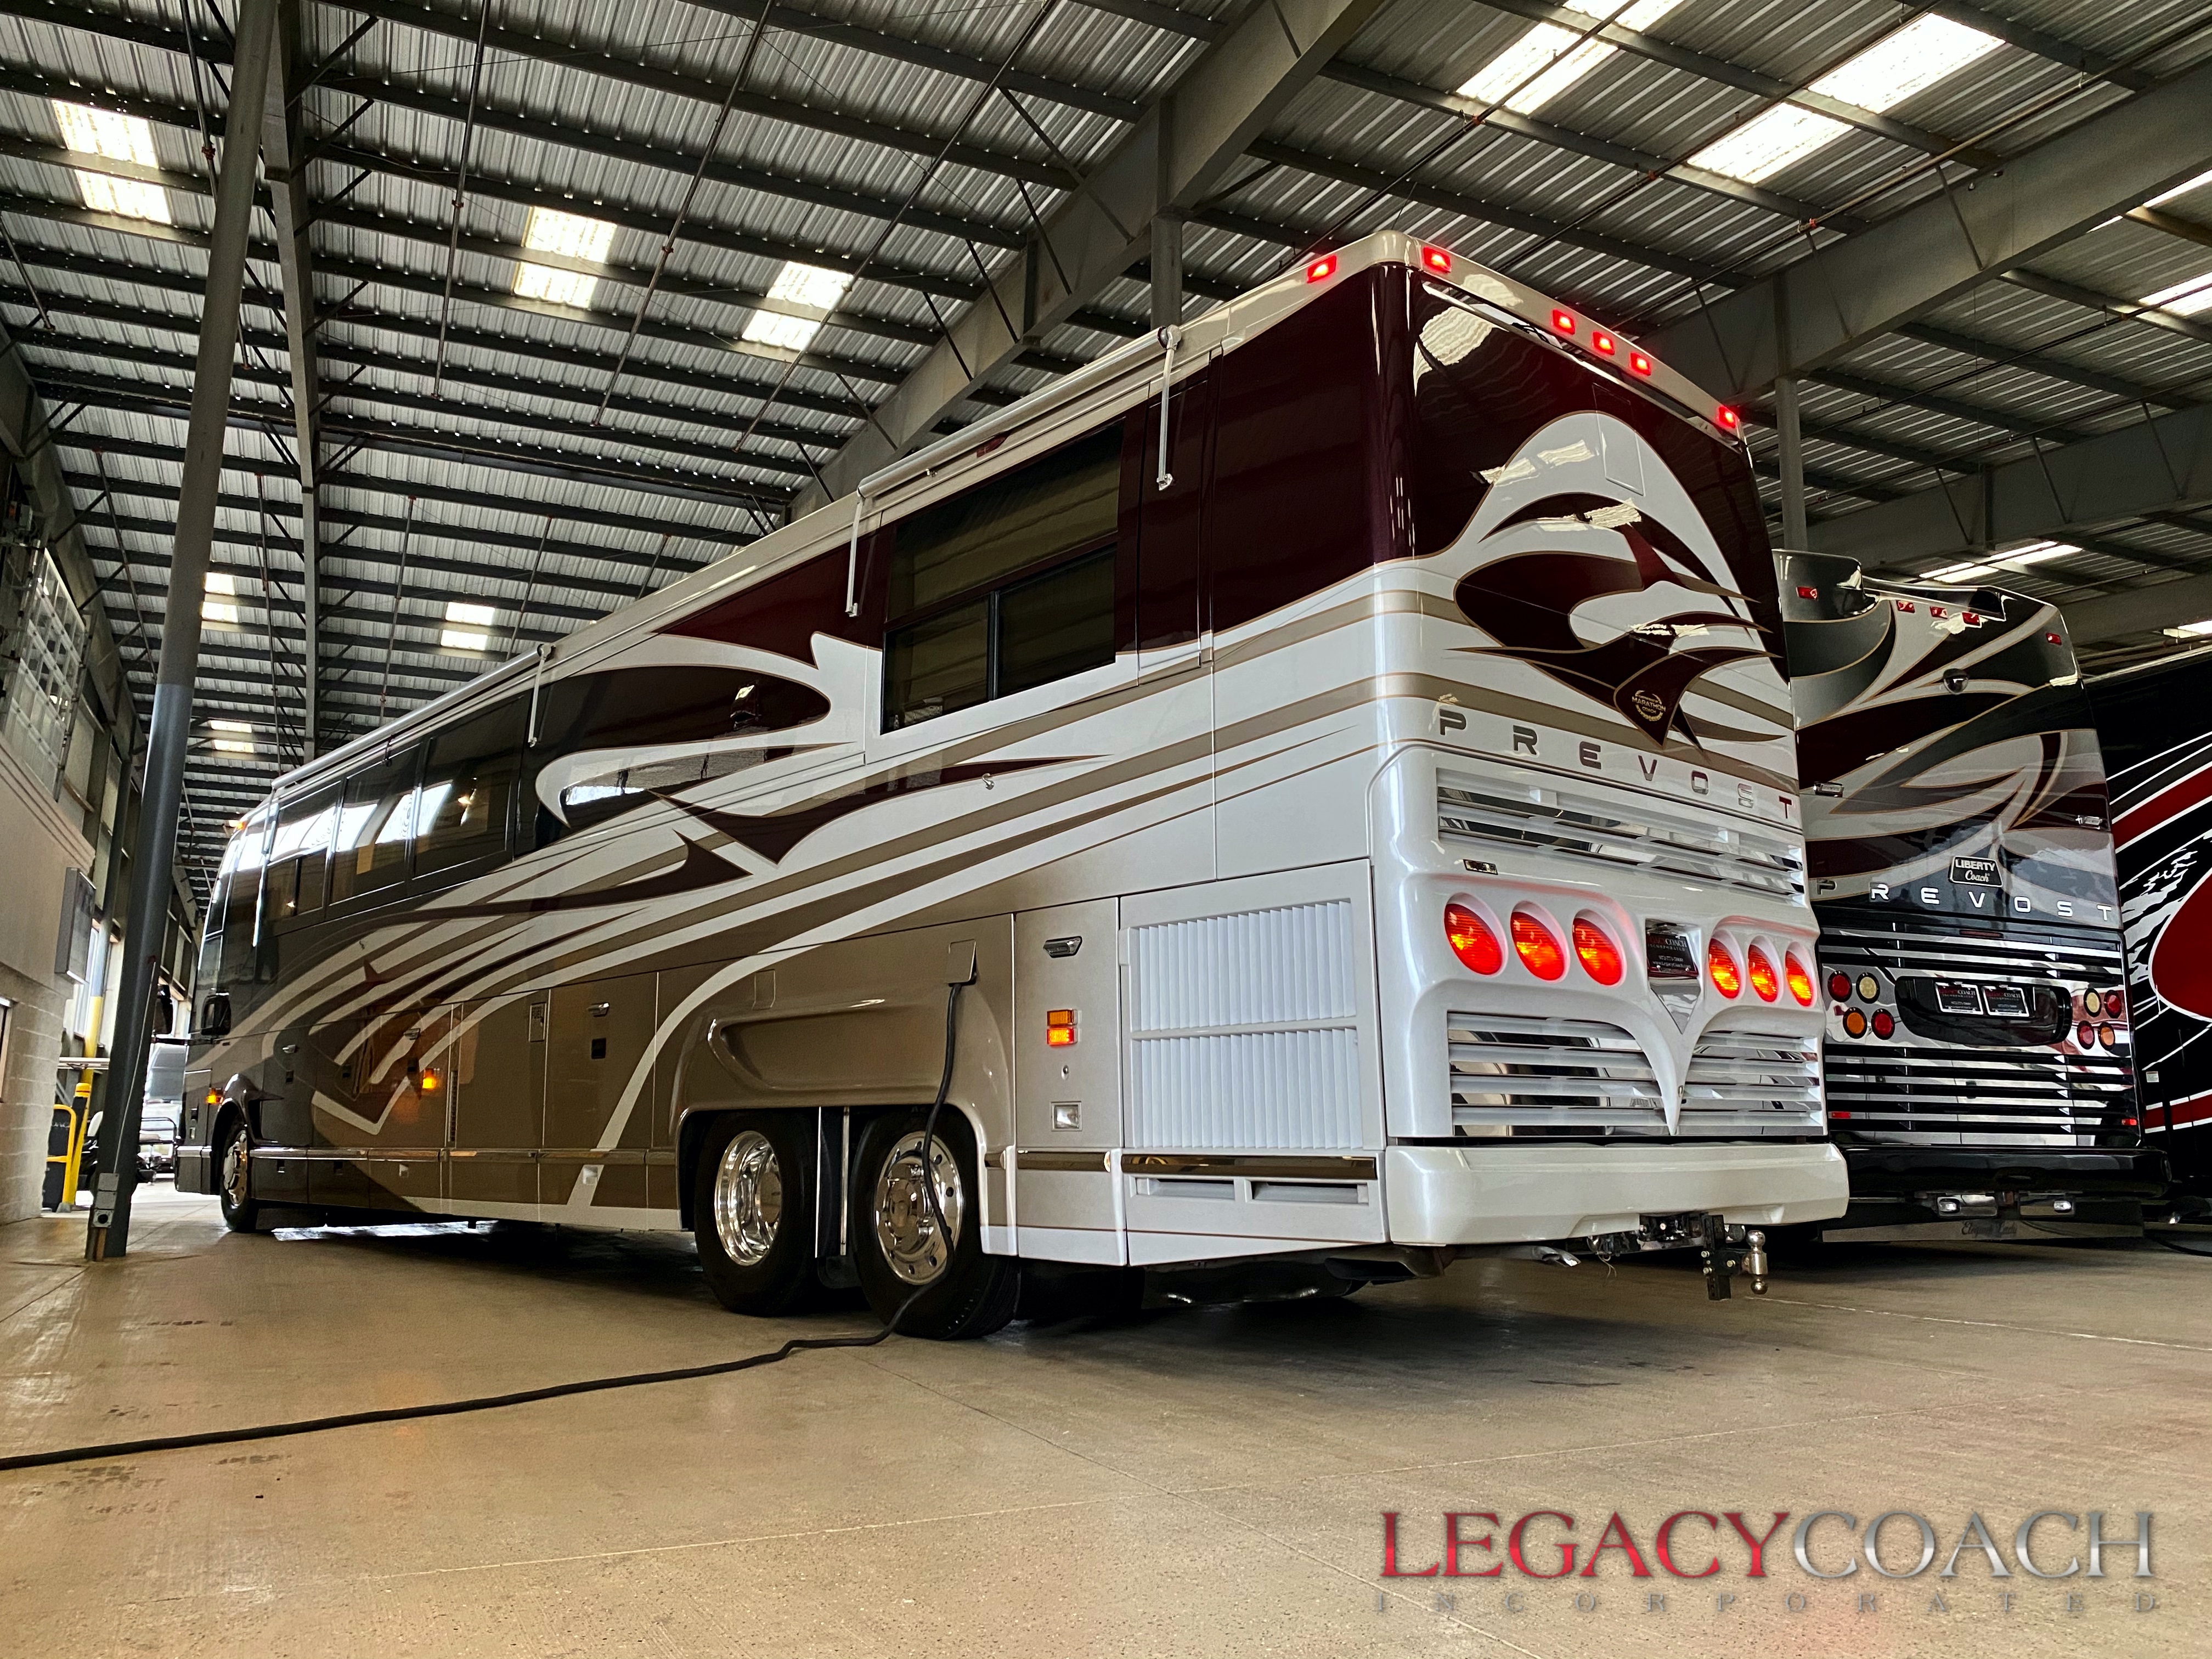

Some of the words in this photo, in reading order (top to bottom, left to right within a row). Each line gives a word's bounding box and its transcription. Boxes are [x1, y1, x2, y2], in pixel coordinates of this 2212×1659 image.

[1632, 696, 1666, 712] MARATHON
[1438, 708, 1793, 819] PREVOST
[1955, 859, 1995, 872] LIBERTY
[1965, 870, 1989, 883] Coach
[1816, 879, 2112, 922] PREVOST
